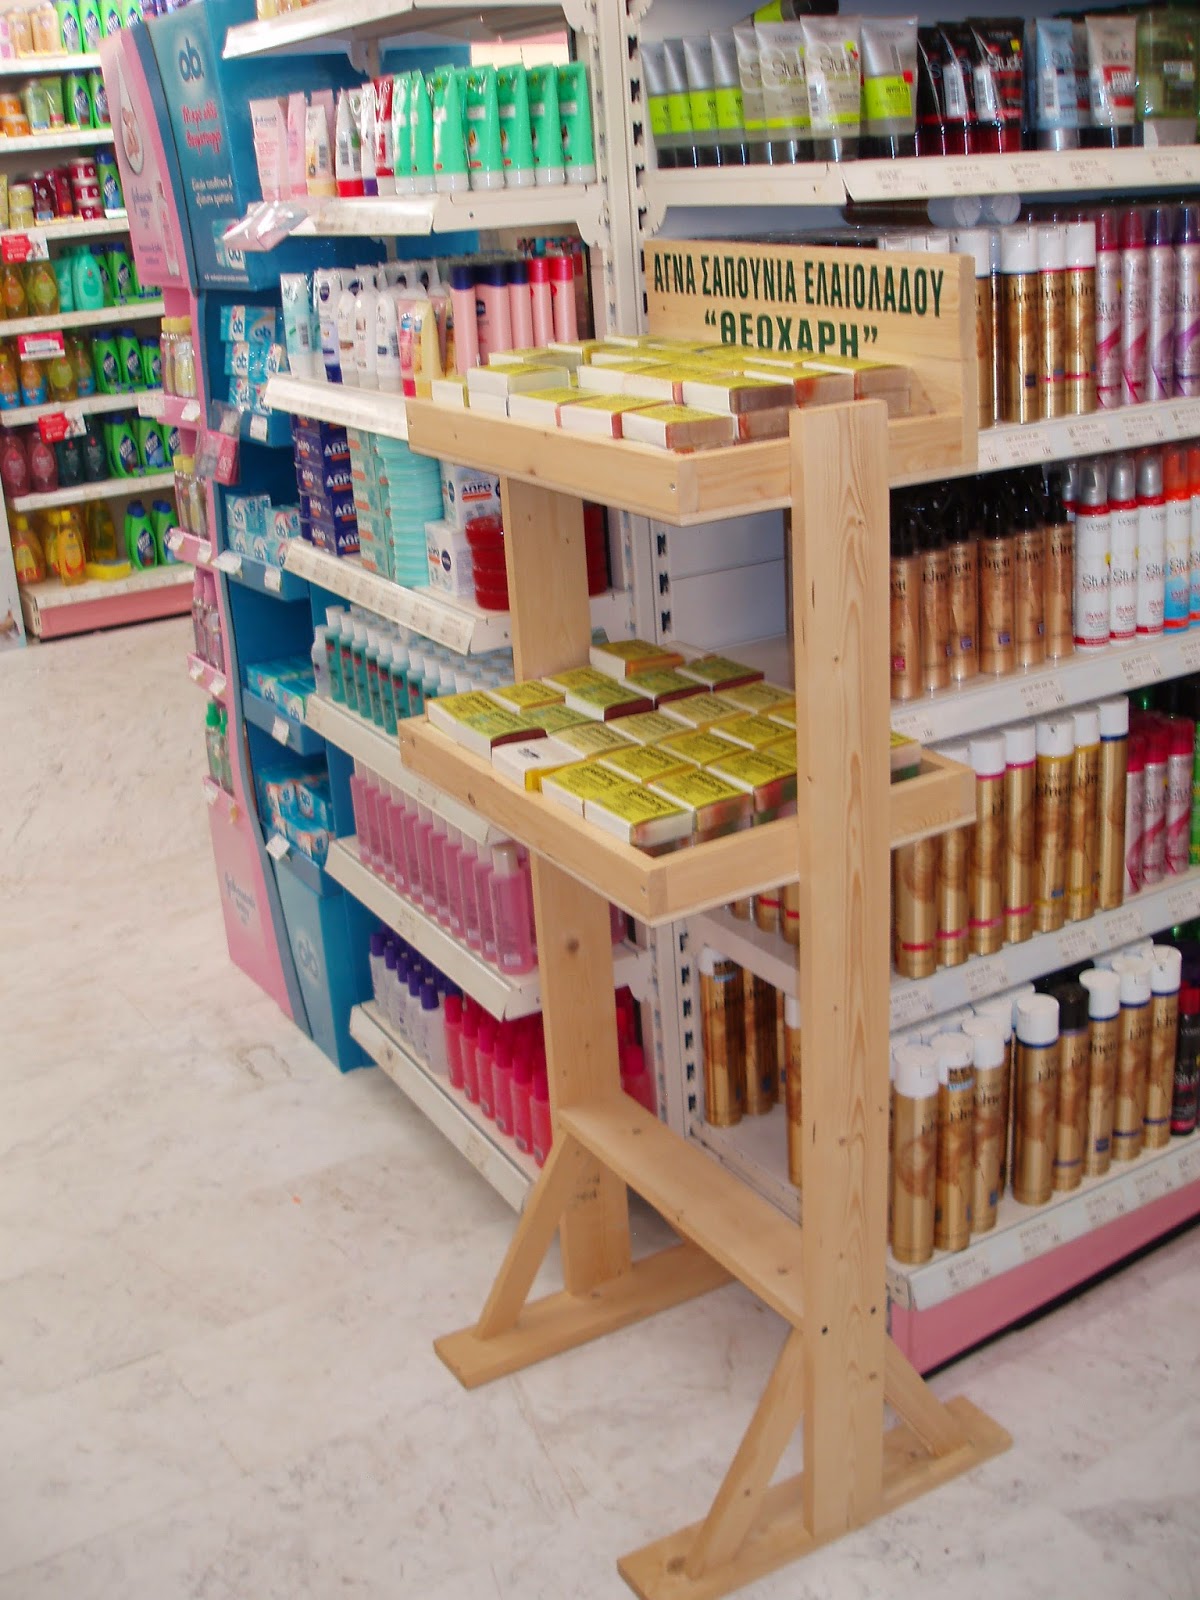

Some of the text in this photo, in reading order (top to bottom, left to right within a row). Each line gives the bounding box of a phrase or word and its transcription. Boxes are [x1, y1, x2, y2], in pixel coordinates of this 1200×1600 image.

[654, 252, 944, 318] ΑΓΝΑ ΣΑΠΟΥΝΙΑ ΕΛΑΙΟΛΑΔΟΥ
